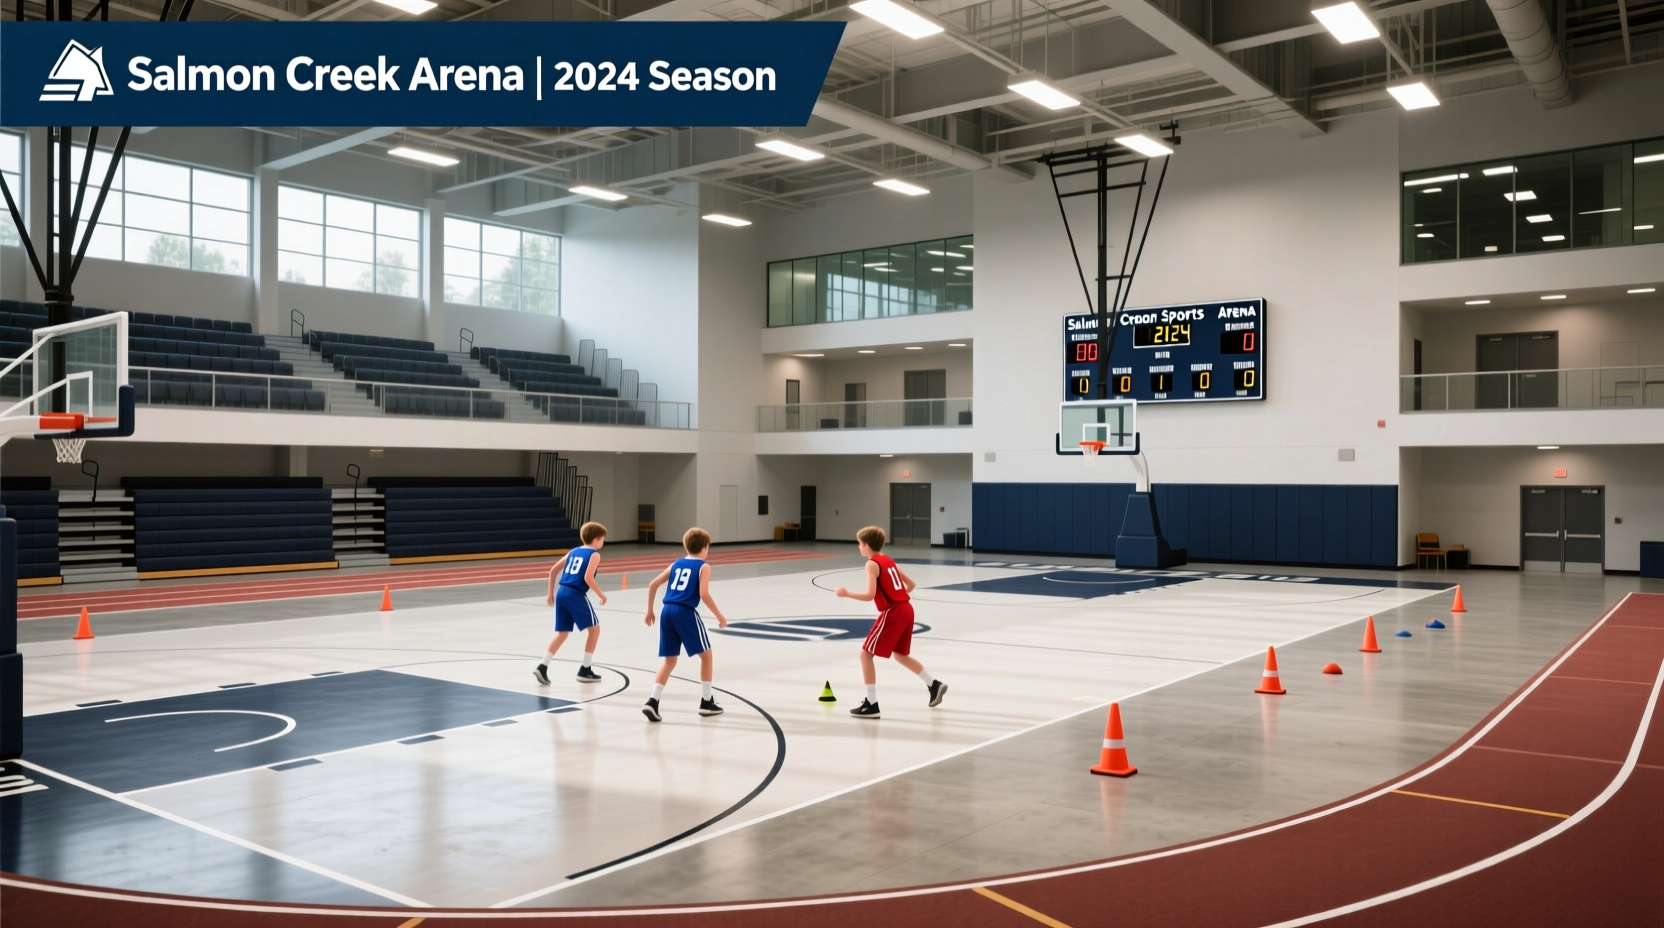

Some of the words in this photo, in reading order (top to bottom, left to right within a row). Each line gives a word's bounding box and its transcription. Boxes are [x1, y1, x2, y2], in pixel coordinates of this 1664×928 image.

[1161, 308, 1205, 325] Sports
[1079, 378, 1089, 394] 0
[1120, 376, 1131, 393] 0
[1200, 372, 1210, 389] 0
[1244, 370, 1255, 387] 0
[564, 556, 584, 575] 18
[670, 568, 692, 591] 19
